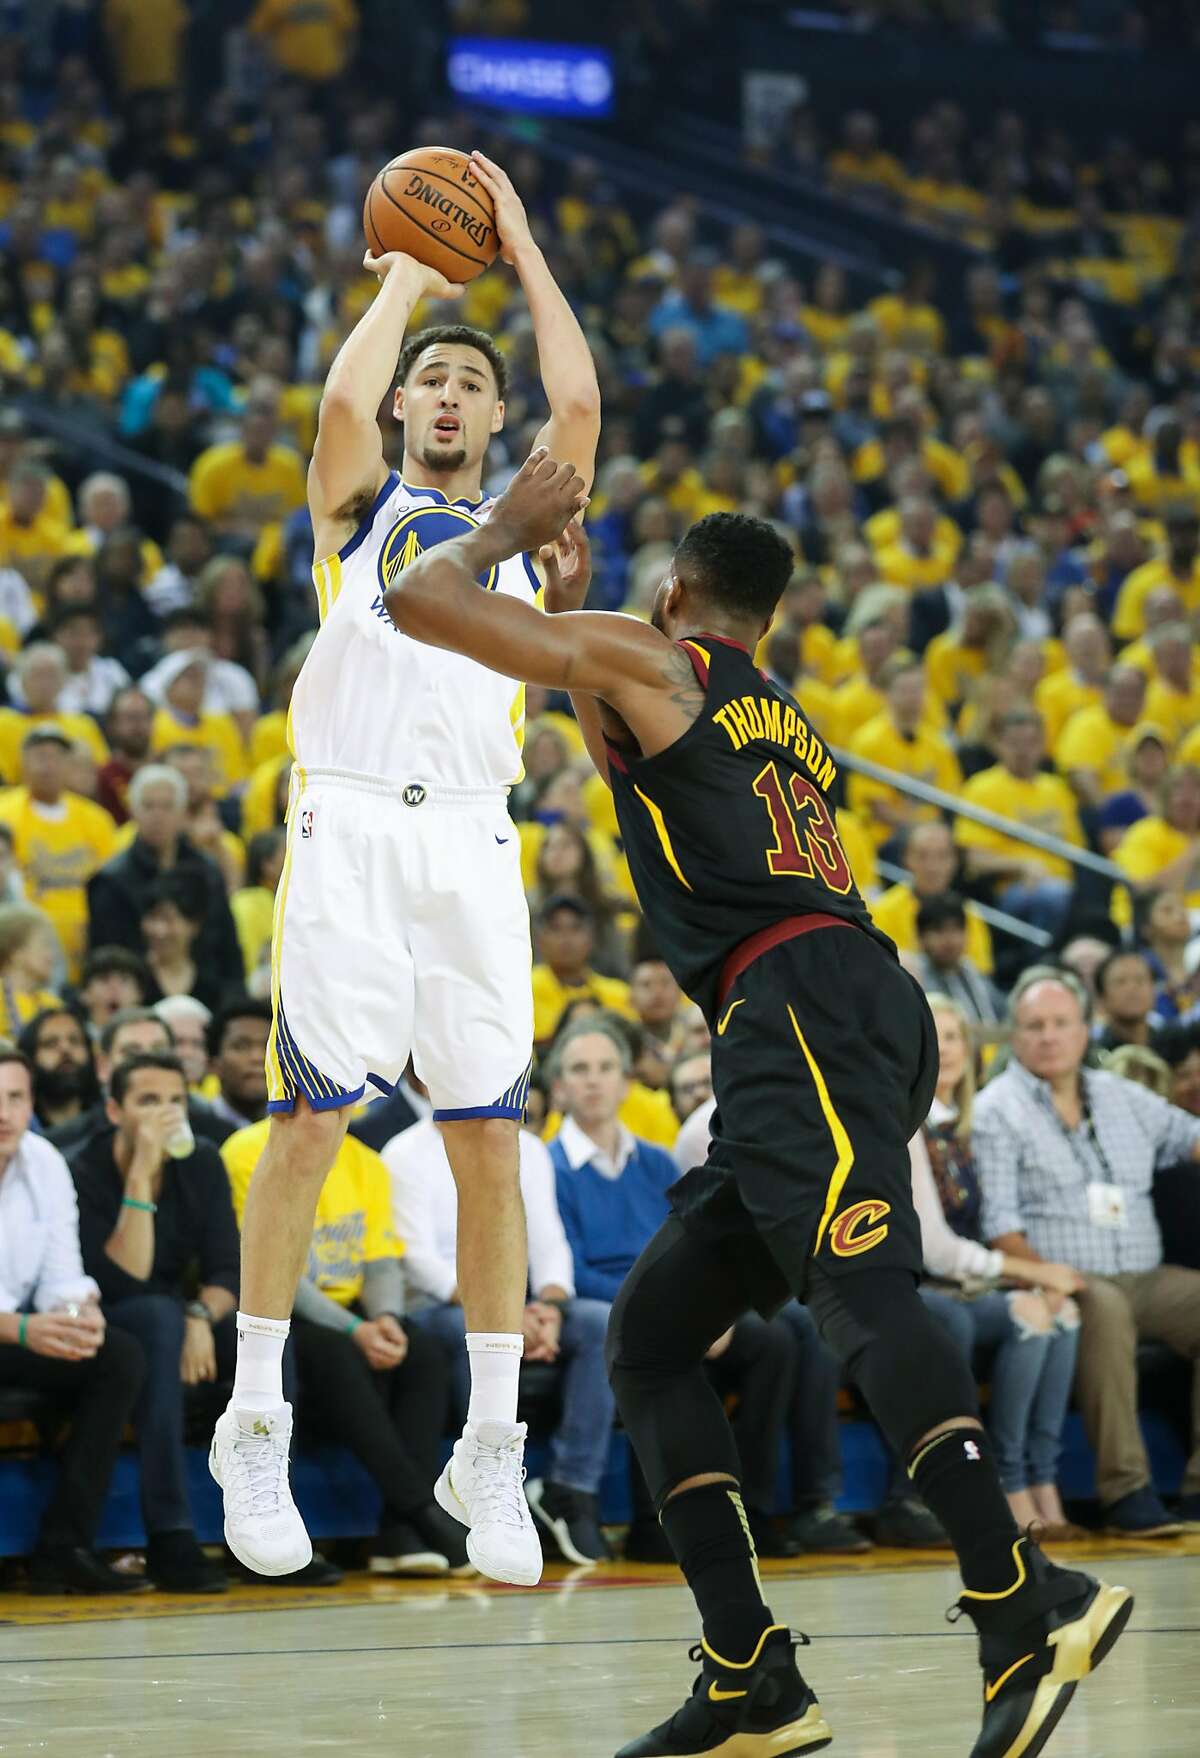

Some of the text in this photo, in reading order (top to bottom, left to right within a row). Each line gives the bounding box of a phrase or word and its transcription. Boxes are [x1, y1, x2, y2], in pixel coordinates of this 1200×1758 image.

[404, 175, 492, 248] SPALDING
[712, 695, 837, 793] THOMPSON
[406, 789, 424, 803] W
[752, 759, 853, 895] 13
